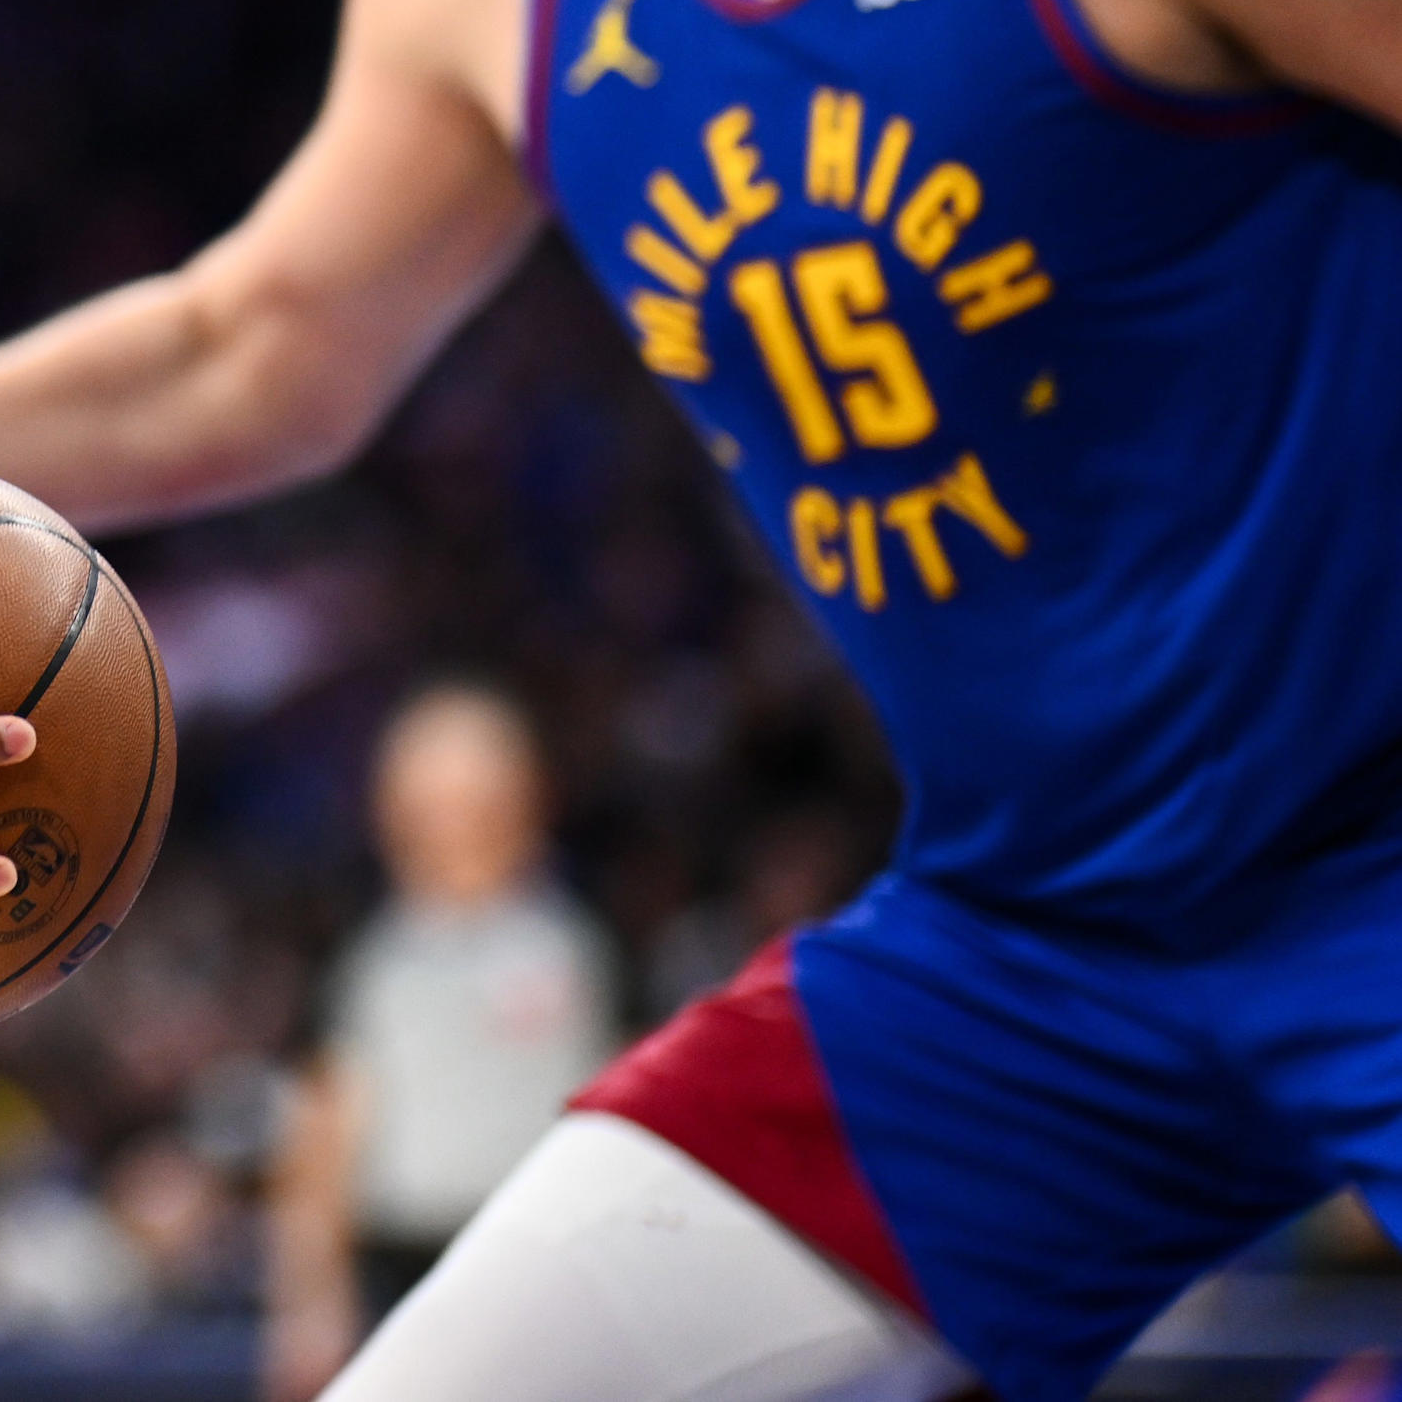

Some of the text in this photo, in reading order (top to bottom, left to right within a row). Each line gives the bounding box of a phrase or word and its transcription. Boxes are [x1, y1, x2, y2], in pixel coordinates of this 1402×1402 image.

[624, 85, 1054, 383] MILE HIGH
[728, 240, 938, 465] 15
[789, 452, 1029, 613] CITY
